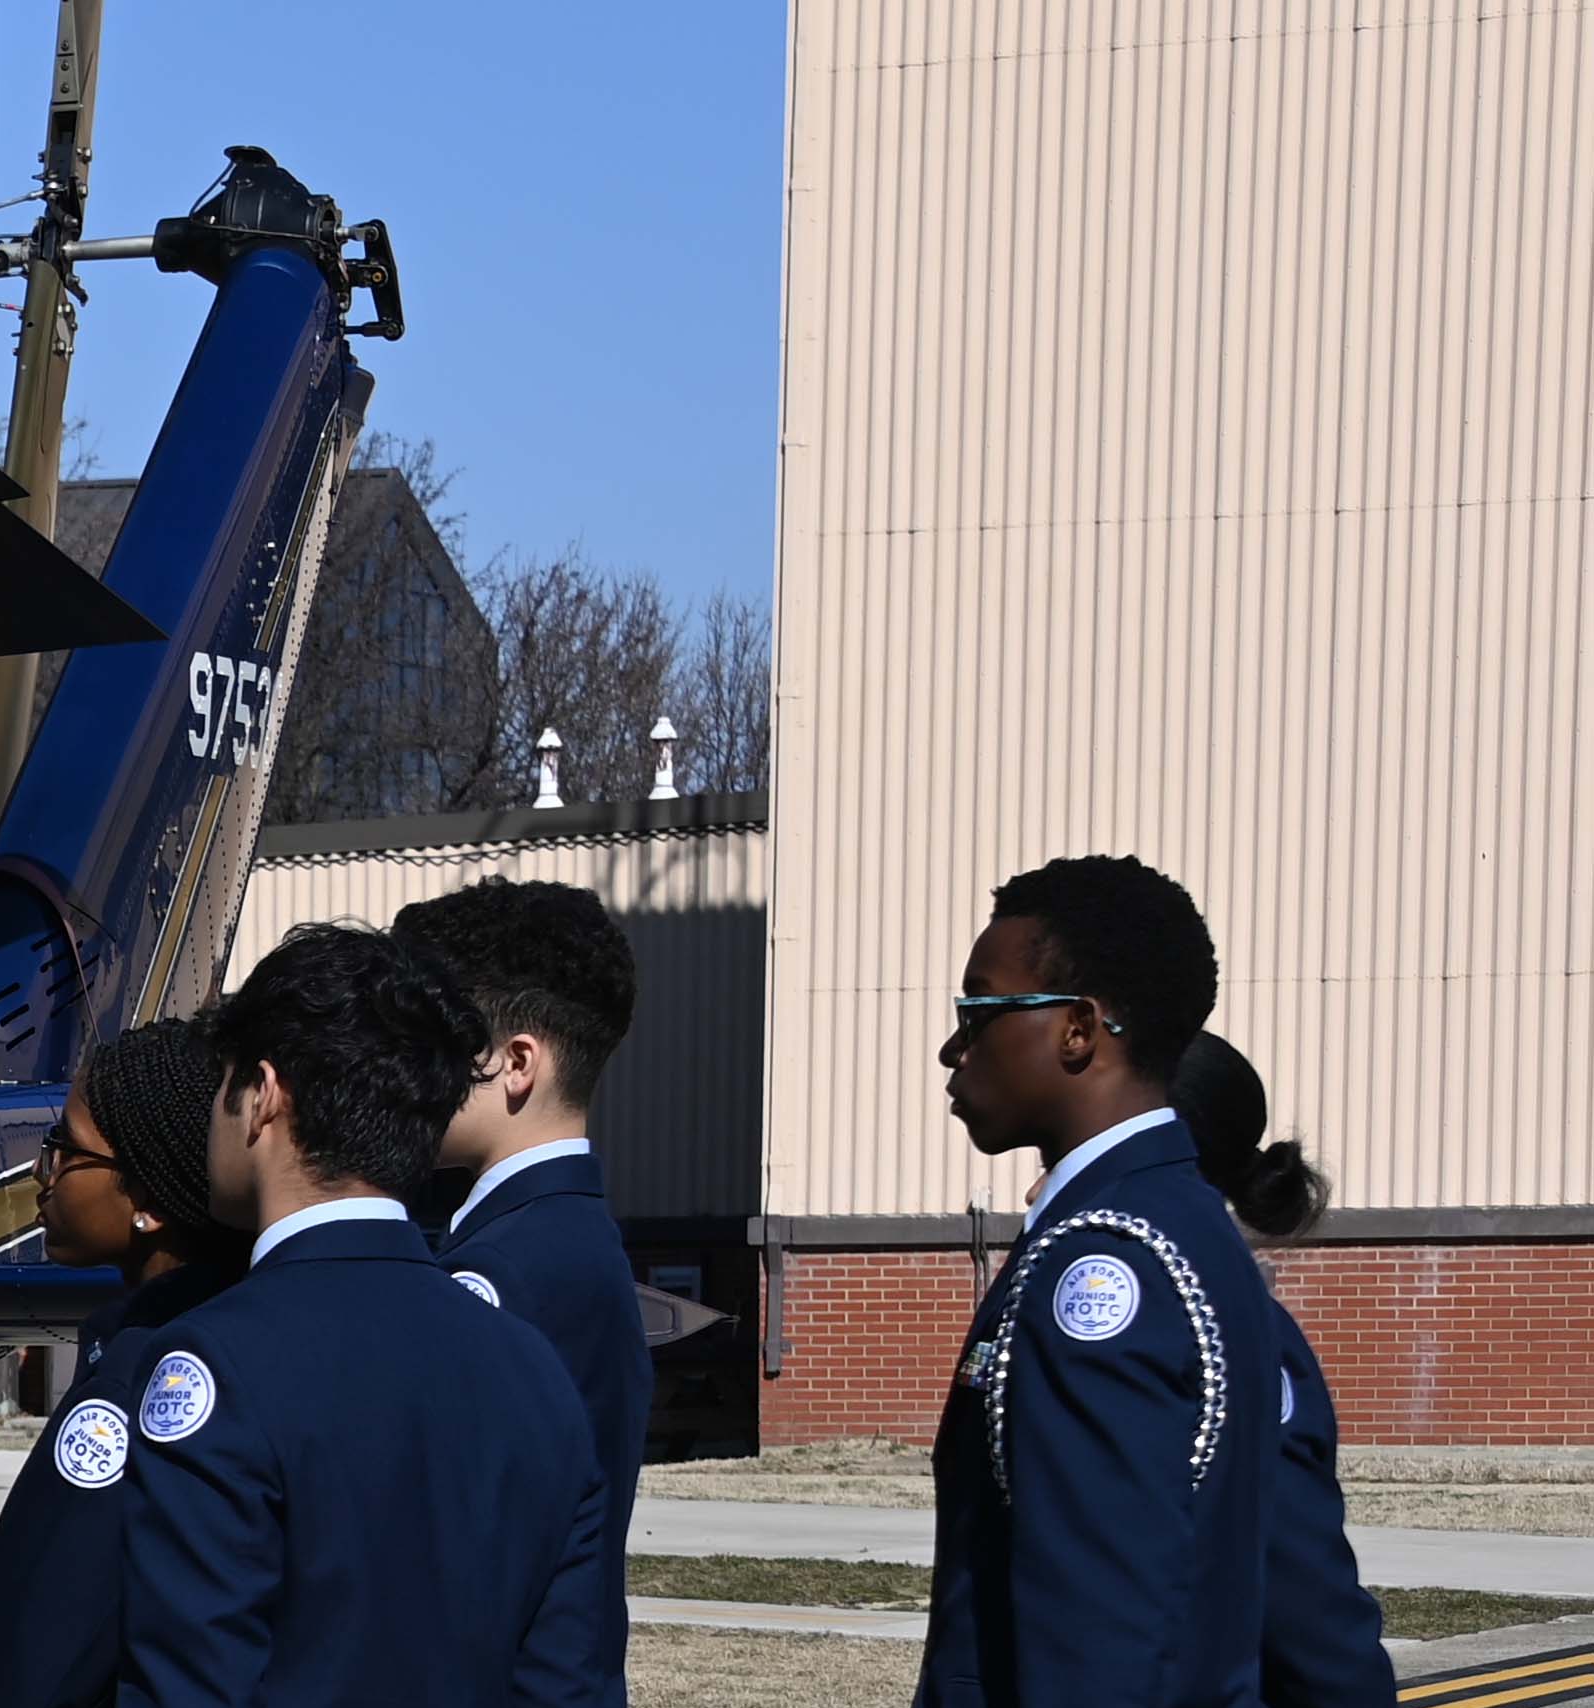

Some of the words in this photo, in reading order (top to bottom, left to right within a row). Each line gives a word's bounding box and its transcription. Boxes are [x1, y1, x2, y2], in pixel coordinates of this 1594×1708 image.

[188, 651, 284, 770] 9753
[1067, 1269, 1086, 1289] AIR
[1090, 1265, 1126, 1291] FORCE
[1064, 1301, 1121, 1317] ROTC
[1069, 1292, 1117, 1302] JUNIOR
[170, 1363, 201, 1389] FORCE
[146, 1401, 195, 1416] ROTC
[152, 1390, 192, 1401] JUNIOR
[74, 1428, 112, 1458] JUNIOR
[79, 1411, 98, 1425] AIR
[102, 1415, 125, 1451] FORCE
[64, 1433, 111, 1473] ROTC
